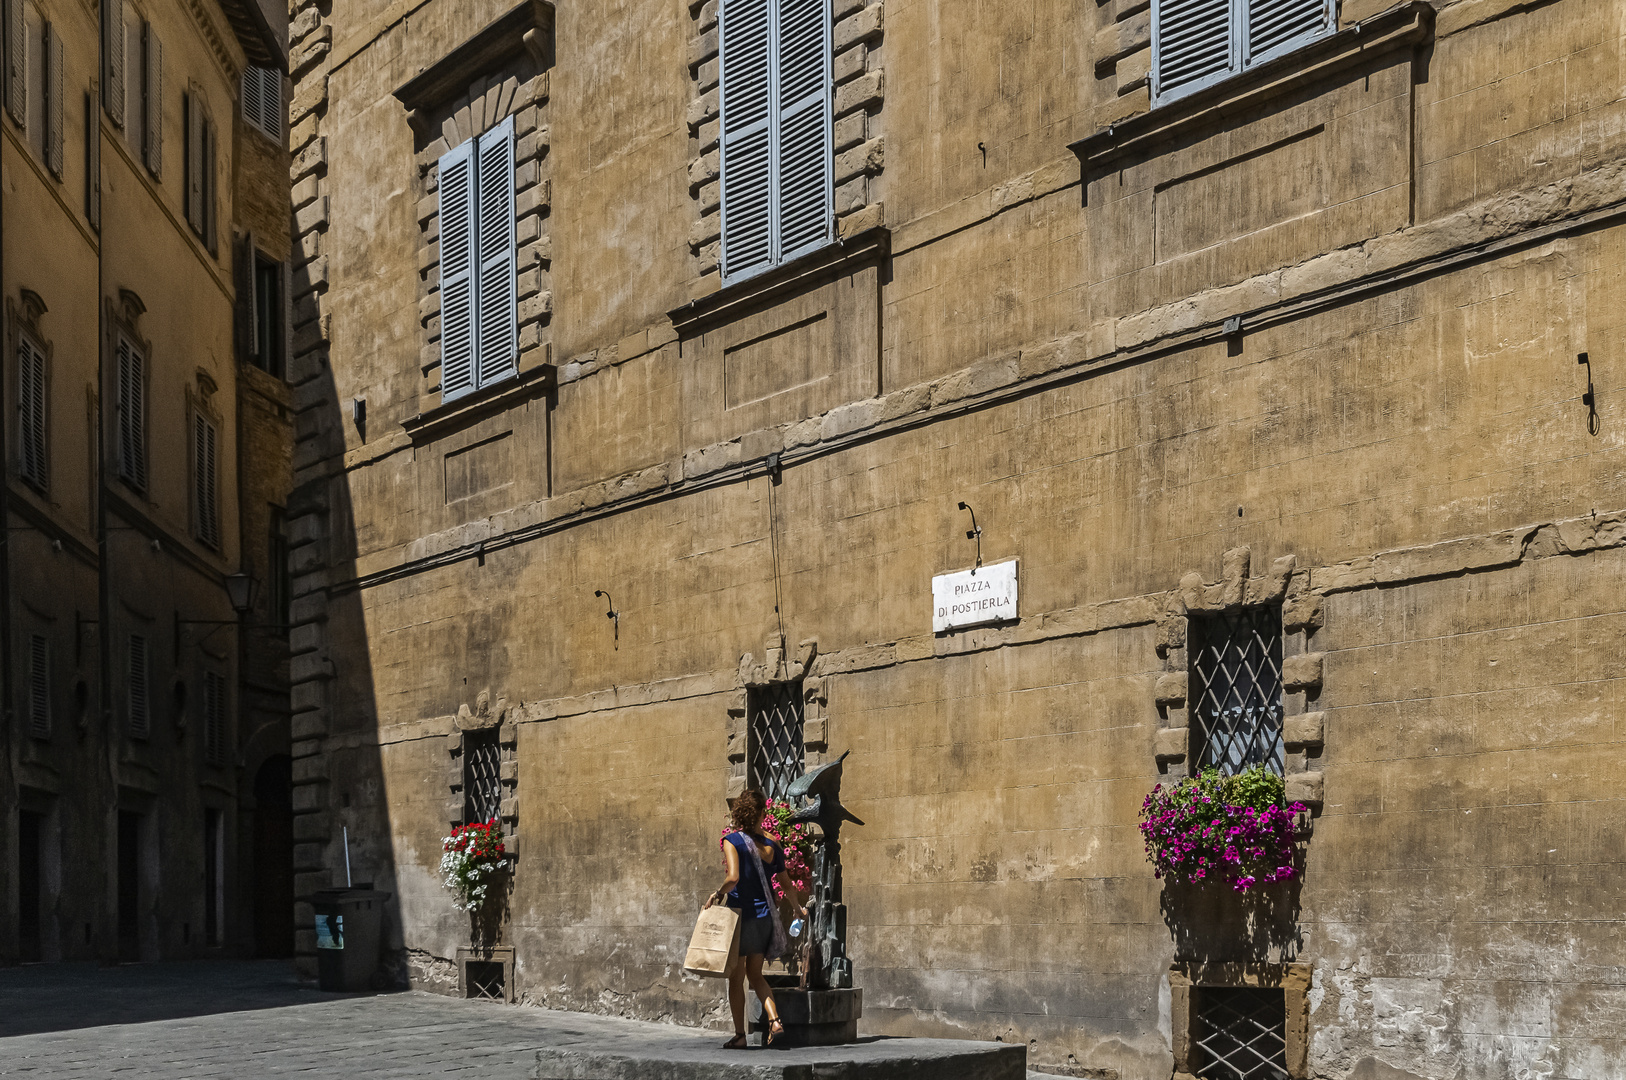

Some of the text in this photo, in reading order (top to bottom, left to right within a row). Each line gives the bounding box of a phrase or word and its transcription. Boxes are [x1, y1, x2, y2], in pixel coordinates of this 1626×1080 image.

[954, 581, 991, 596] PIAZZA
[938, 596, 1010, 618] DI POSTIERLA
